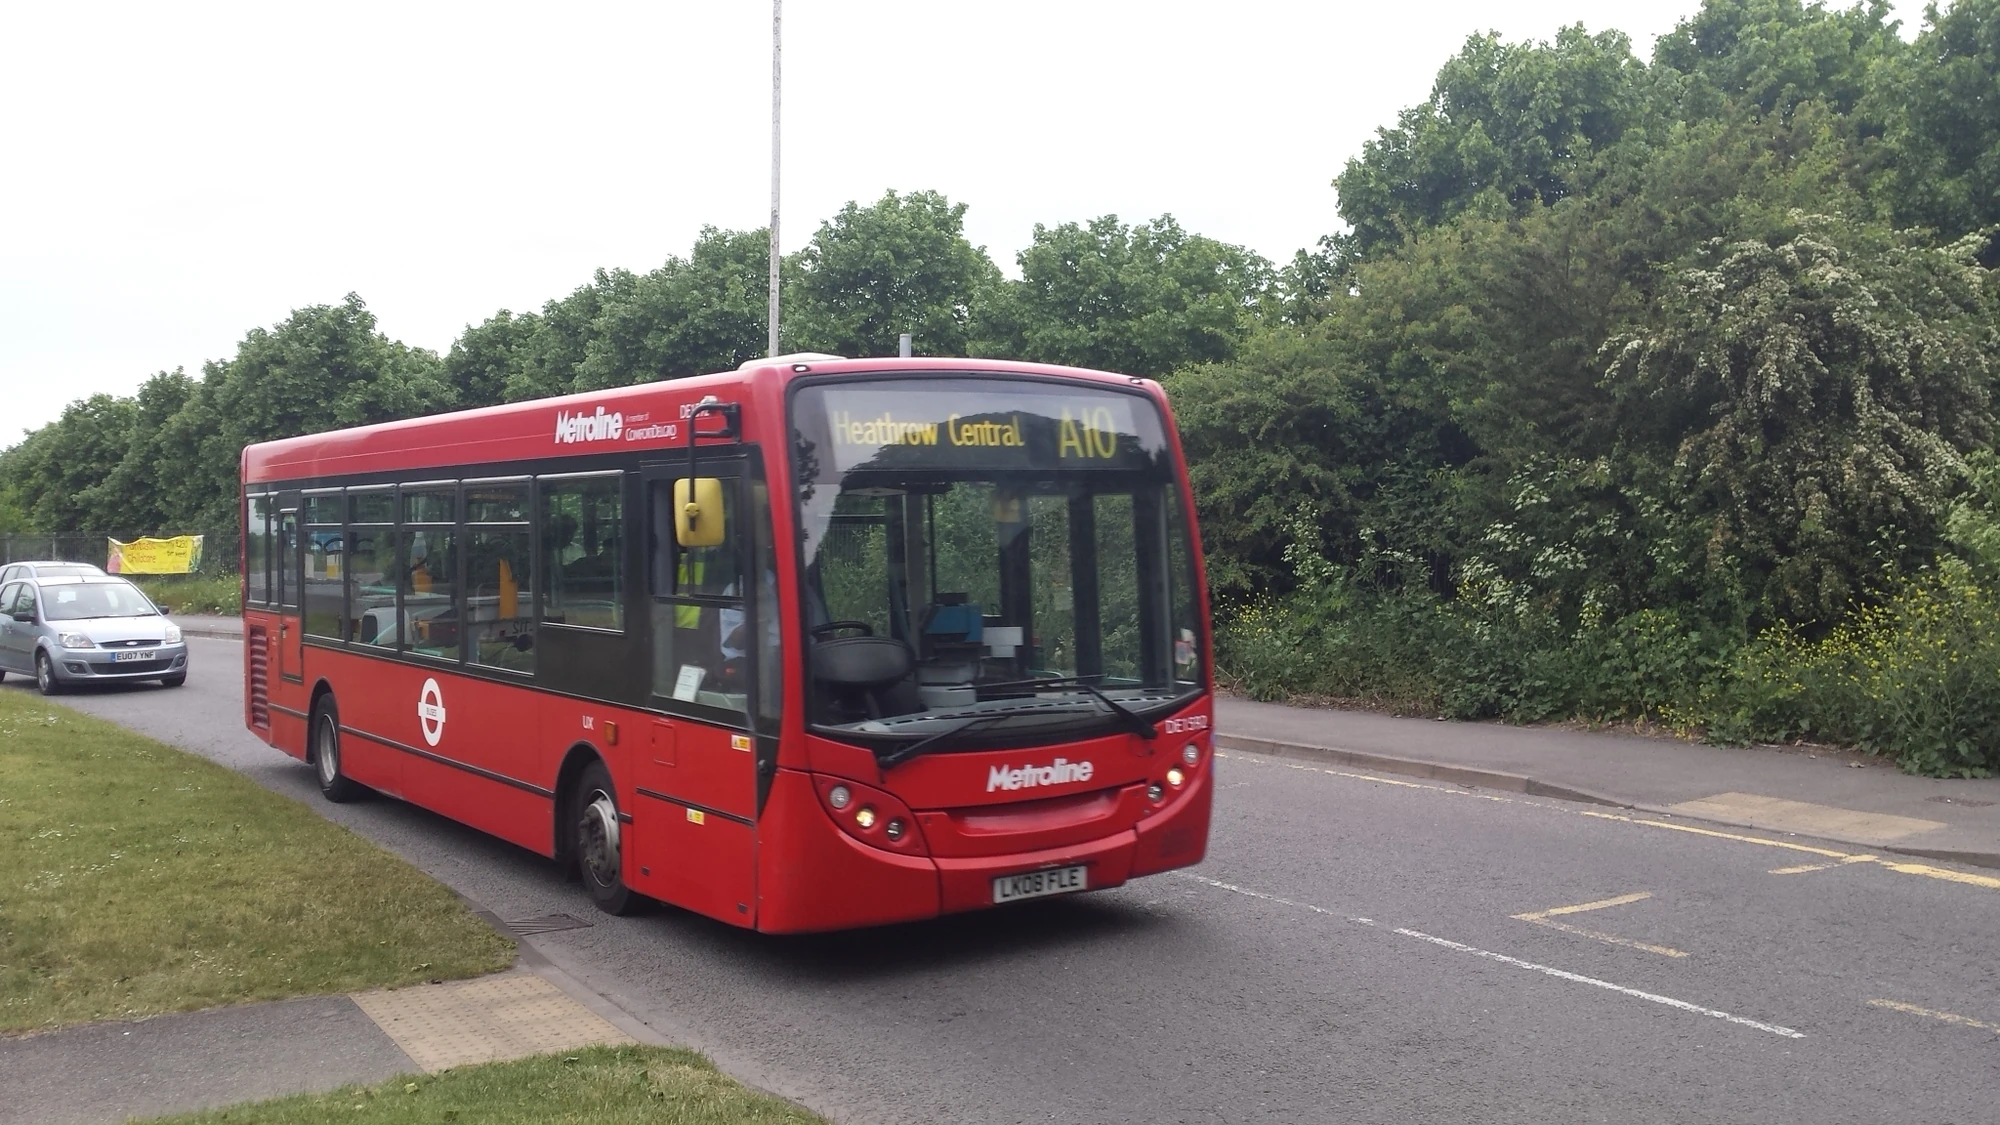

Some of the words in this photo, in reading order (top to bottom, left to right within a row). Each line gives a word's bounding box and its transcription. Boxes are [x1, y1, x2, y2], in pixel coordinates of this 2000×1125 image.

[554, 406, 624, 444] Metroline
[834, 410, 939, 446] Heathrow
[949, 413, 1025, 447] Central
[1059, 406, 1116, 459] A10
[117, 652, 138, 660] EU07
[140, 651, 154, 659] YNF
[986, 758, 1094, 793] Metroline
[1001, 876, 1043, 899] LK08
[1049, 868, 1080, 890] FLE
